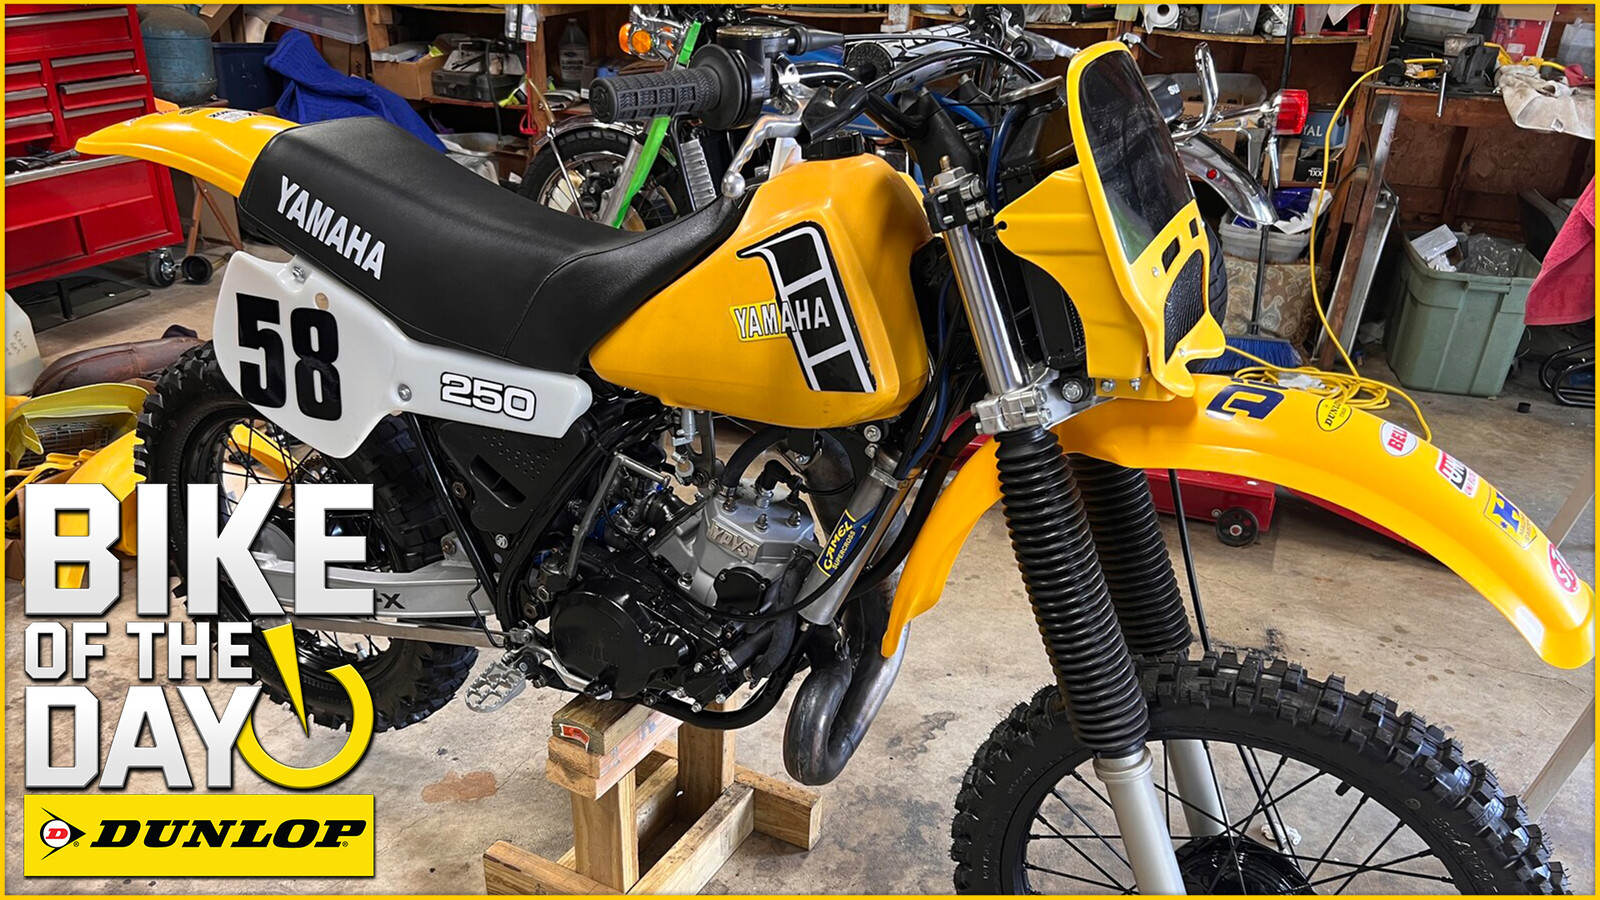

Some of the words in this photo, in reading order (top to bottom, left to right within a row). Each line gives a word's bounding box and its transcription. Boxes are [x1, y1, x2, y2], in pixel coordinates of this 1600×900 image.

[278, 175, 388, 281] YAMAHA
[733, 296, 831, 339] YAMAHA
[236, 292, 342, 421] 58
[440, 372, 536, 421] 250
[823, 520, 854, 571] CAMEL
[832, 530, 856, 571] SUPERCROSS
